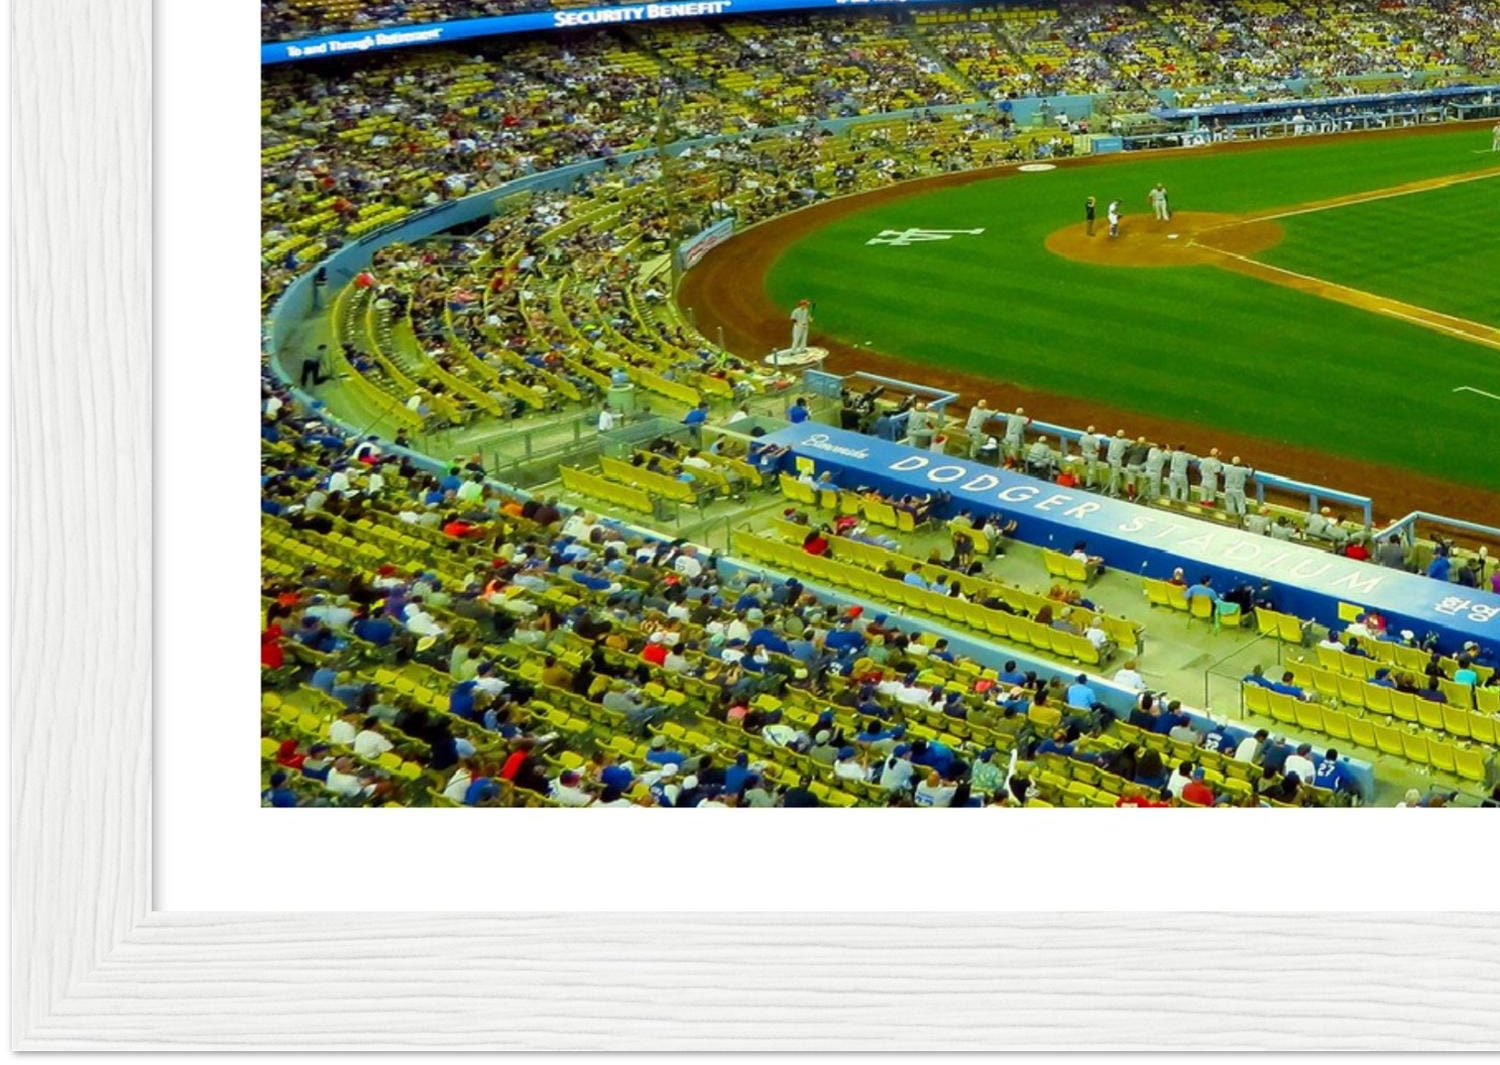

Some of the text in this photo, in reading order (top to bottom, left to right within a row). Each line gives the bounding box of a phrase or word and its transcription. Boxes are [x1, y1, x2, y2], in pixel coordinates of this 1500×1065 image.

[553, 0, 724, 28] SECURITY BENEFIT
[287, 45, 302, 57] To
[303, 42, 327, 56] and
[329, 36, 375, 51] Through
[888, 455, 1387, 594] DODGER STADIUM
[1317, 762, 1336, 778] 27
